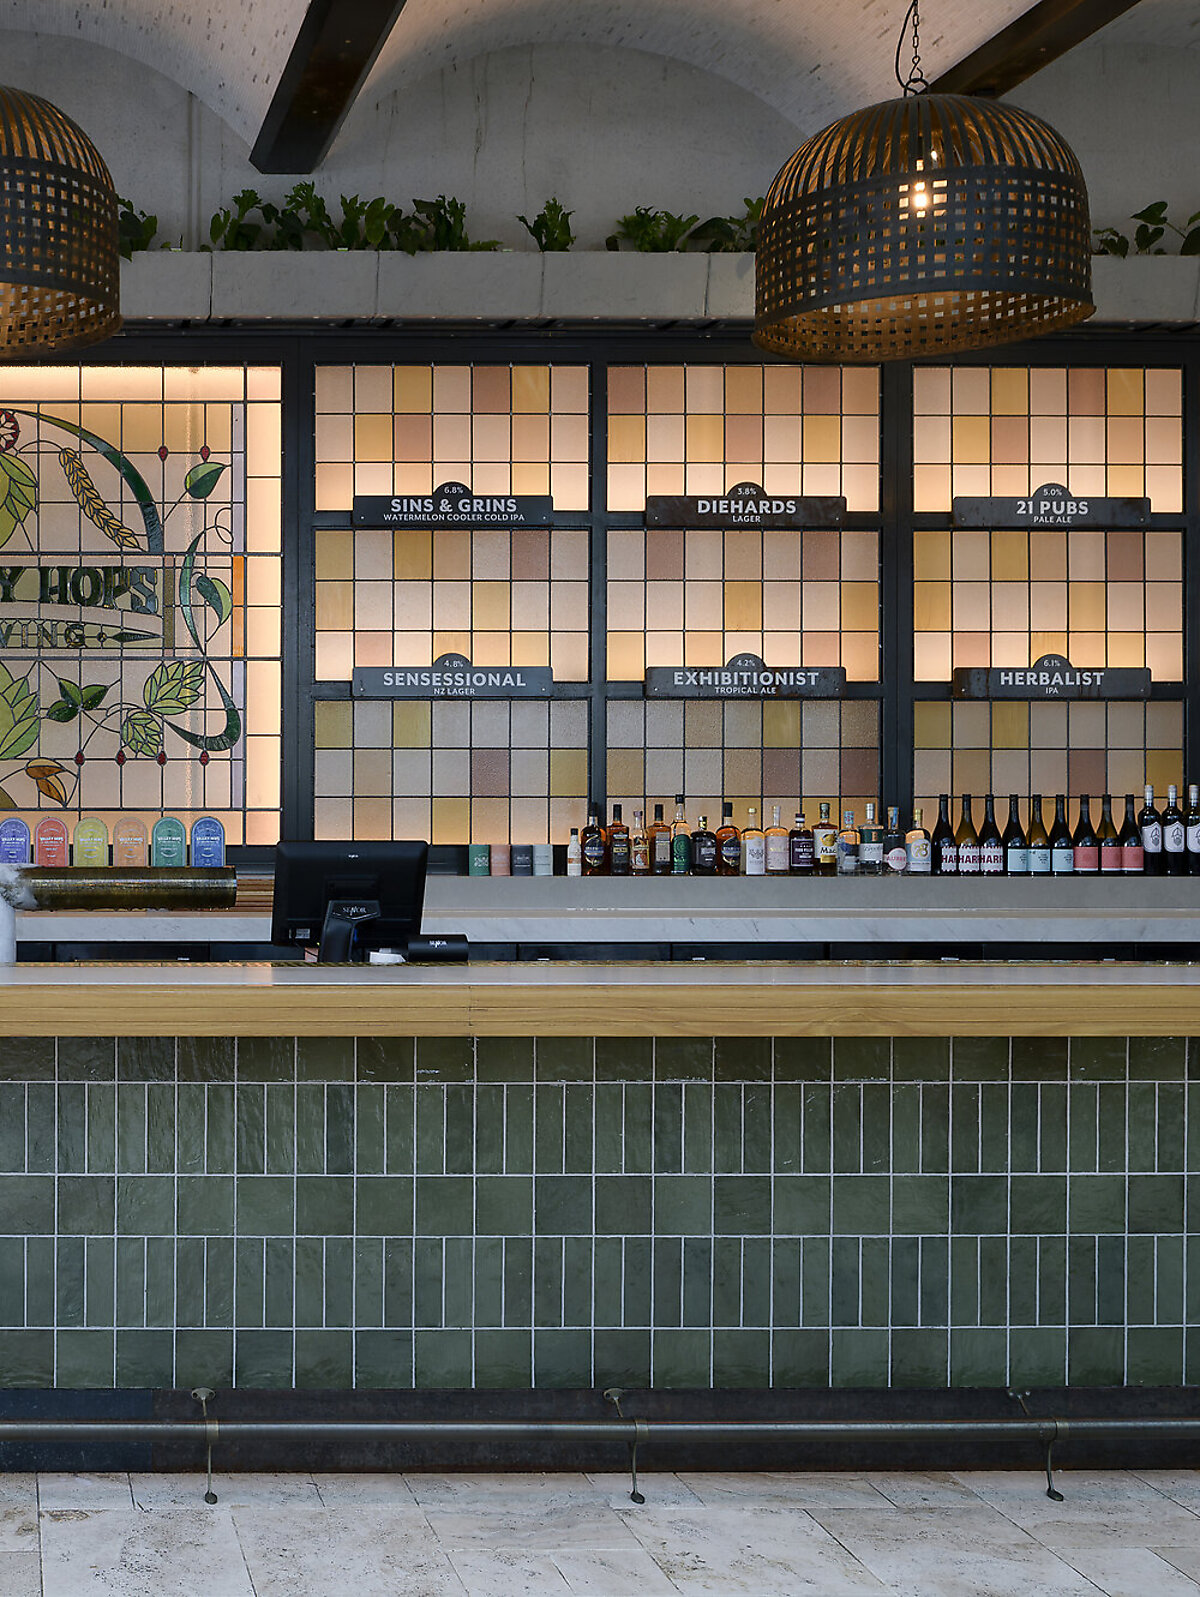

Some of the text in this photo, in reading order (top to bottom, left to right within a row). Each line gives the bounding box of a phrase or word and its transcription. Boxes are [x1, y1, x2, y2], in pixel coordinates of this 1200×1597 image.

[444, 486, 464, 494] 6.8%
[390, 498, 518, 512] SINS & GRINS
[697, 500, 797, 514] DIEHARDS
[1016, 501, 1089, 515] 21 PUBS
[732, 515, 761, 523] LAGER
[39, 566, 159, 615] HOPS
[444, 660, 464, 668] 4.8%
[736, 659, 756, 667] 4.2%
[383, 673, 527, 686] SENSESSIONAL
[673, 672, 820, 686] EXHIBITIONIST
[1000, 672, 1105, 686] HERBALIST
[433, 688, 476, 696] NZ LAGER
[715, 687, 777, 695] TROPICAL ALE
[1045, 687, 1059, 695] IPA
